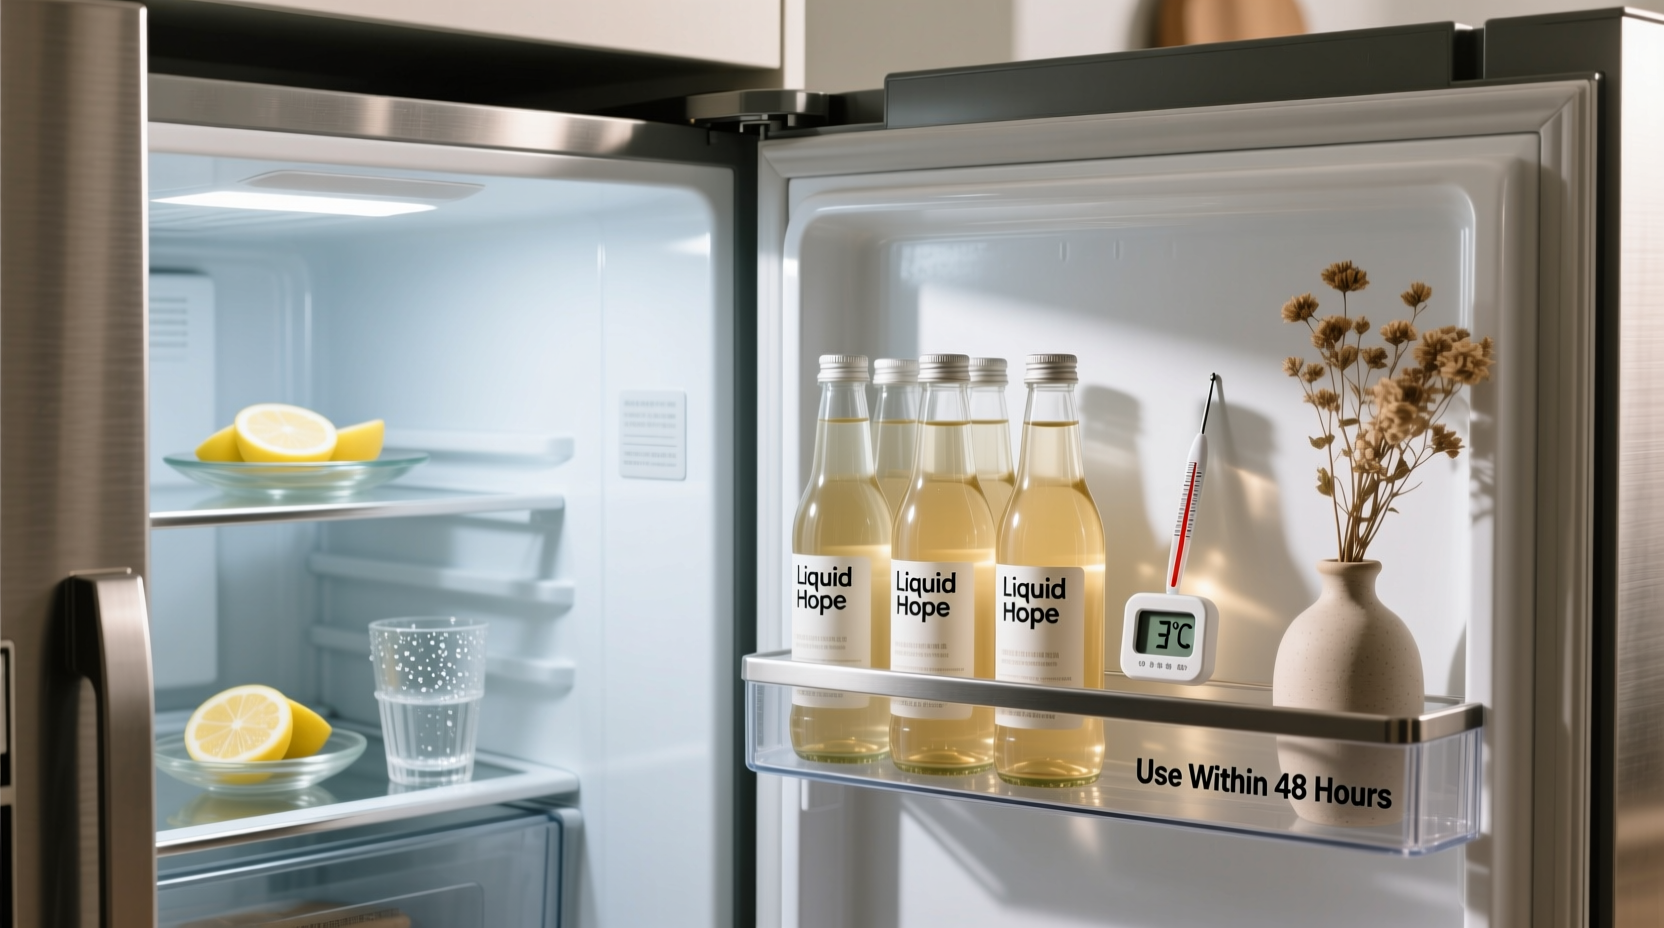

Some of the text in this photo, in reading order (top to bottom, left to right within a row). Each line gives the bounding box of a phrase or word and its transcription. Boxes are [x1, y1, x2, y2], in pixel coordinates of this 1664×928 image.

[797, 565, 852, 592] Liquid
[896, 570, 956, 598] Liquid
[1003, 576, 1066, 603] Liquid
[797, 589, 847, 615] Hope
[896, 595, 950, 622] Hope
[1003, 602, 1060, 629] Hope
[1136, 758, 1392, 809] Use Within 48 Hours
